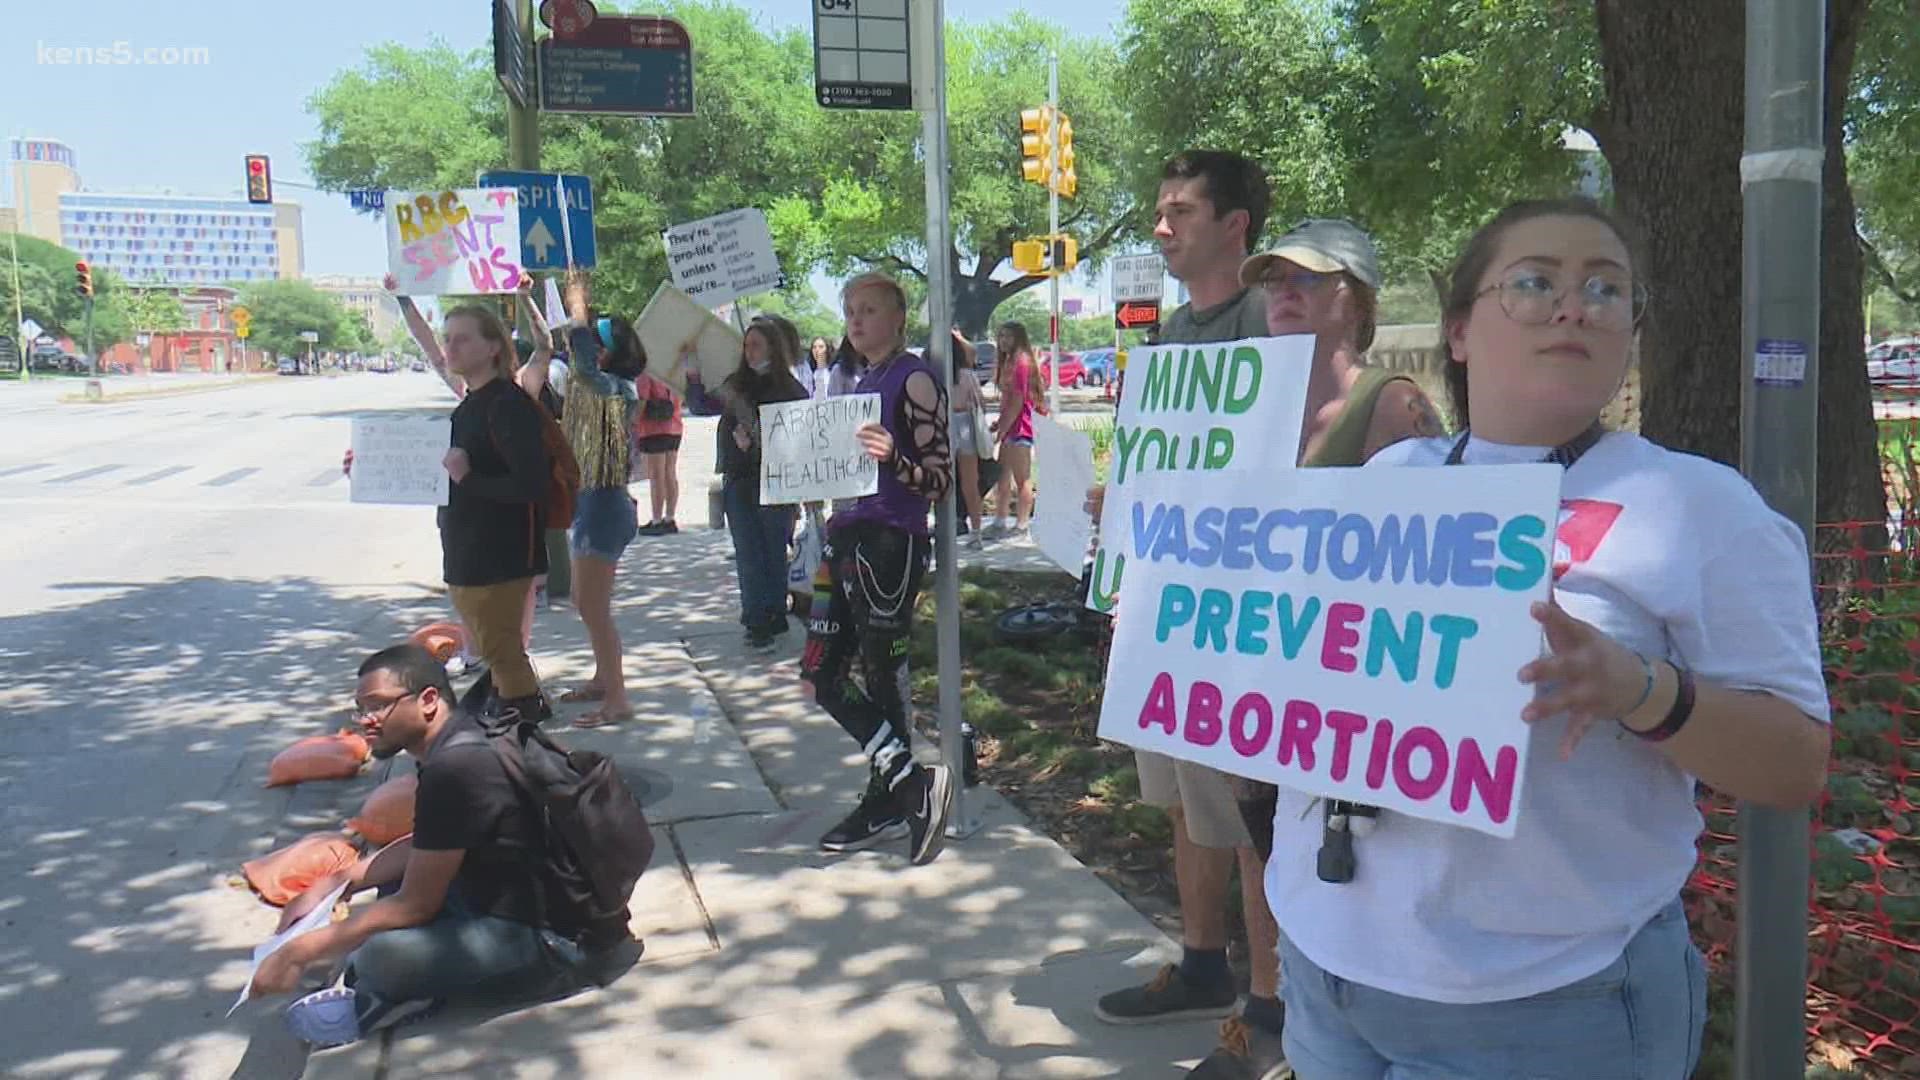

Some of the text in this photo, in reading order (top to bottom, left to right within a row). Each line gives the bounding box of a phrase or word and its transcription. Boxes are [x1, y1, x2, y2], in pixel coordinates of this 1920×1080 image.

[681, 262, 717, 279] unless
[1140, 346, 1263, 415] MIND
[768, 397, 874, 446] ABORTION
[810, 427, 831, 450] IS
[1131, 500, 1546, 591] VASECTOMIES
[1155, 583, 1479, 690] PREVENT
[1138, 671, 1518, 824] ABORTION
